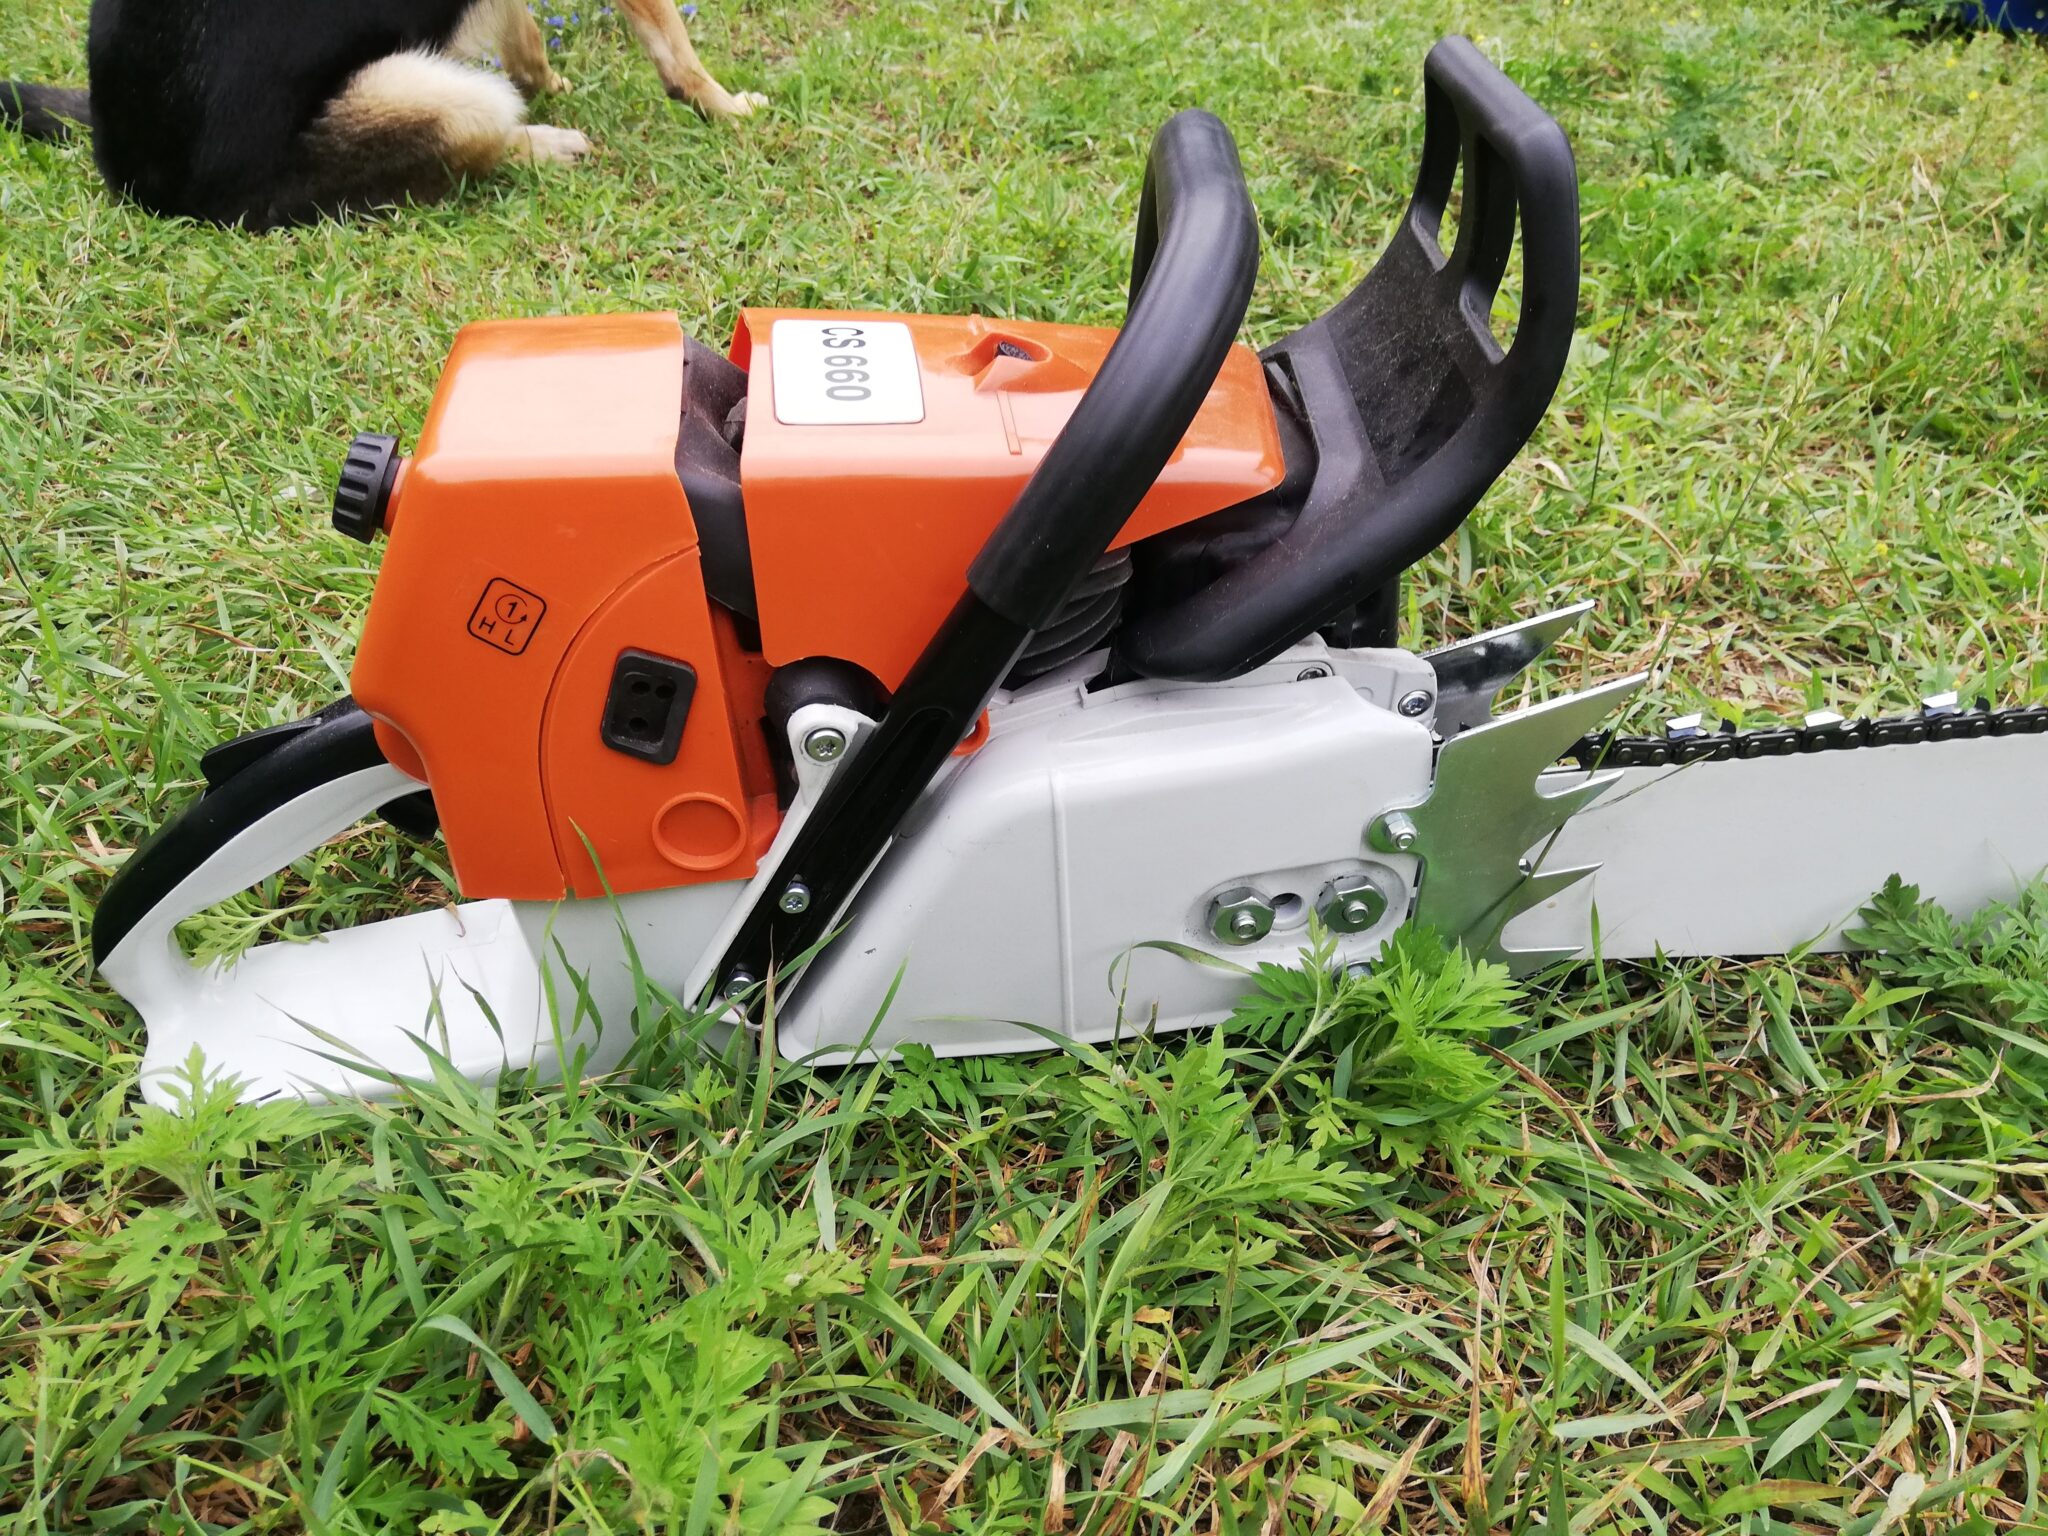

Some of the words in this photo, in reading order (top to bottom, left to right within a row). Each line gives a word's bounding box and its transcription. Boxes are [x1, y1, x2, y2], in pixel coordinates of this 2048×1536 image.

[822, 327, 866, 348] CS
[824, 355, 872, 401] 660
[508, 602, 518, 618] 1
[478, 616, 496, 634] H
[504, 629, 514, 646] L
